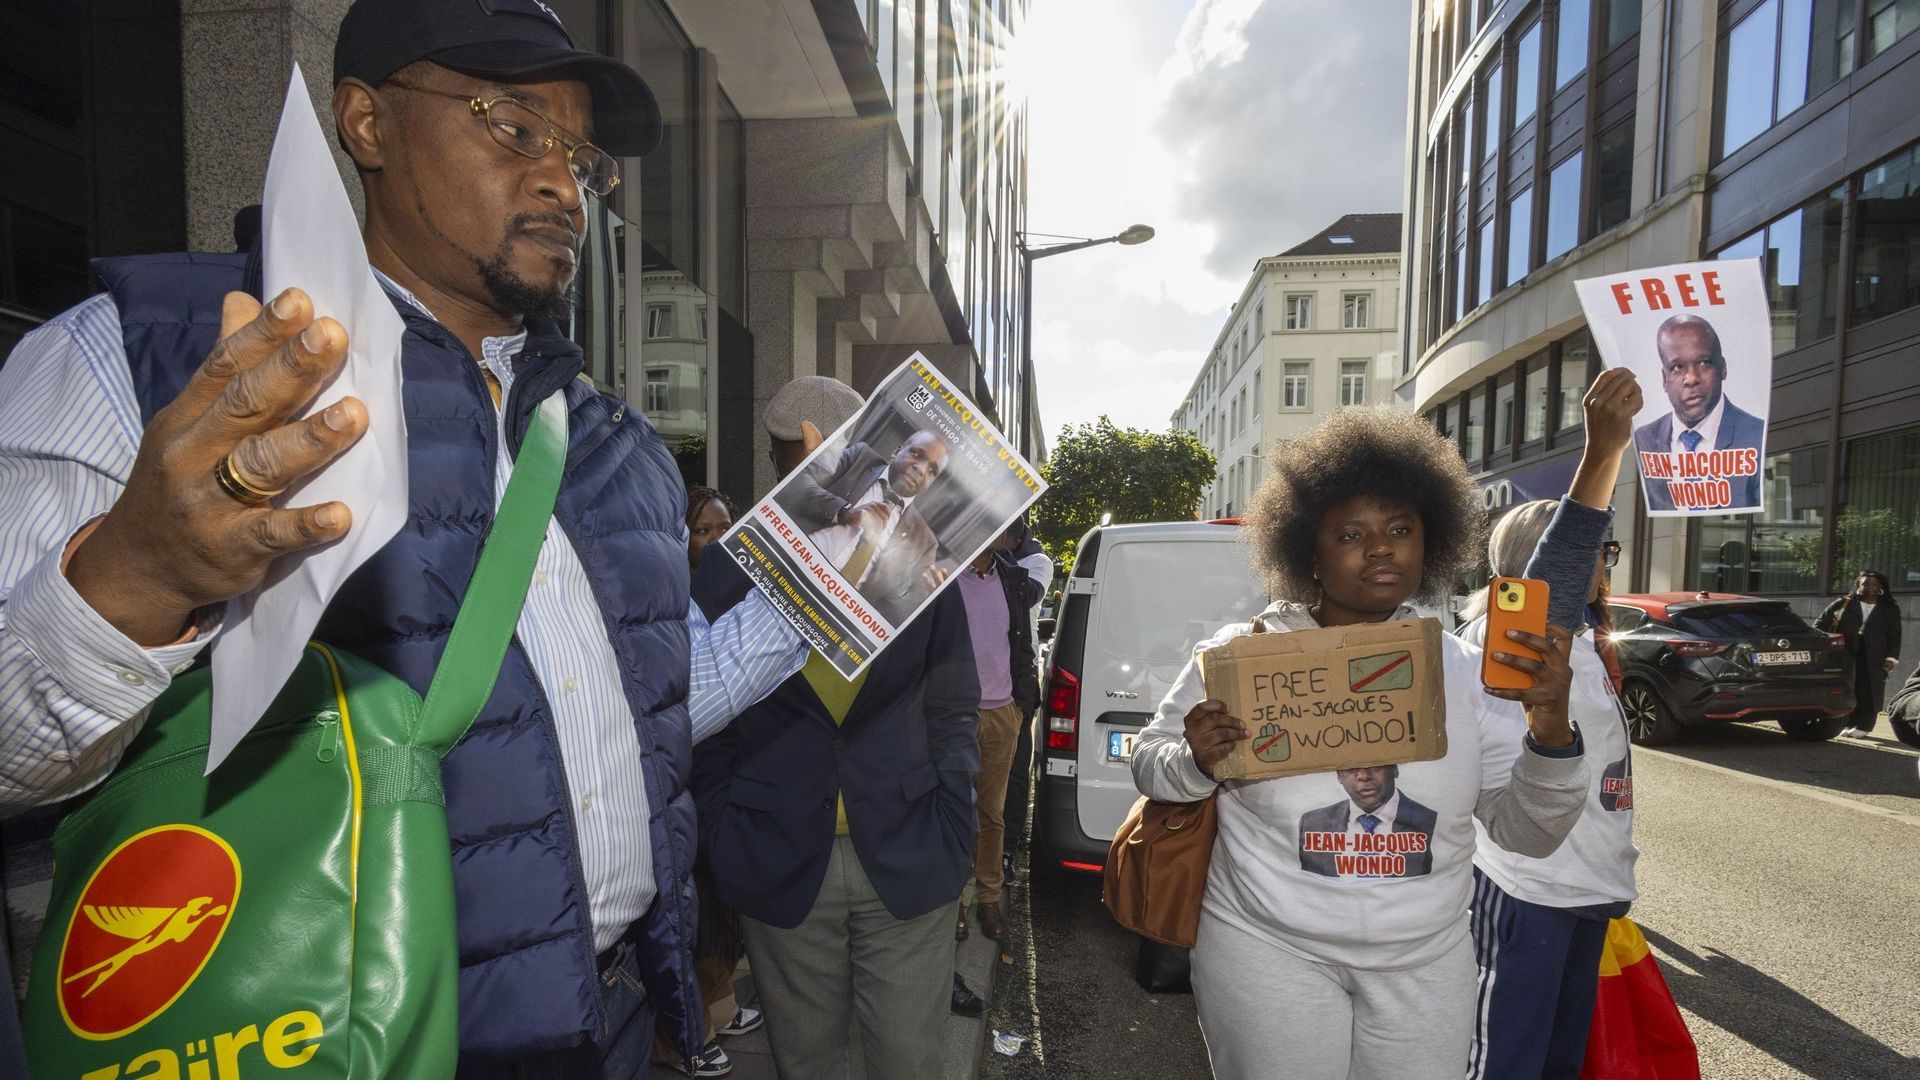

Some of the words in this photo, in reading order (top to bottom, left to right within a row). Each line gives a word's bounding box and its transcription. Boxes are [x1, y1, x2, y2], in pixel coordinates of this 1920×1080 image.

[1610, 271, 1726, 315] FREE
[911, 361, 996, 448] JEAN-JACQUES
[926, 409, 938, 422] DE
[1640, 449, 1757, 479] JEAN-JACQUES
[1668, 480, 1731, 507] WONDO
[737, 531, 768, 564] AMBASSADE
[764, 561, 775, 571] DE
[771, 568, 781, 579] LA
[762, 576, 775, 591] RUE
[772, 587, 789, 608] MARIE
[787, 602, 797, 616] DE
[795, 613, 830, 649] BOURGOGNE
[1105, 690, 1138, 699] VITO
[1253, 667, 1329, 702] FREE
[1251, 695, 1394, 722] JEAN-JACQUES
[1294, 710, 1417, 749] WONDO!
[1303, 832, 1427, 854] JEAN-JACQUES
[1335, 855, 1405, 875] WONDO
